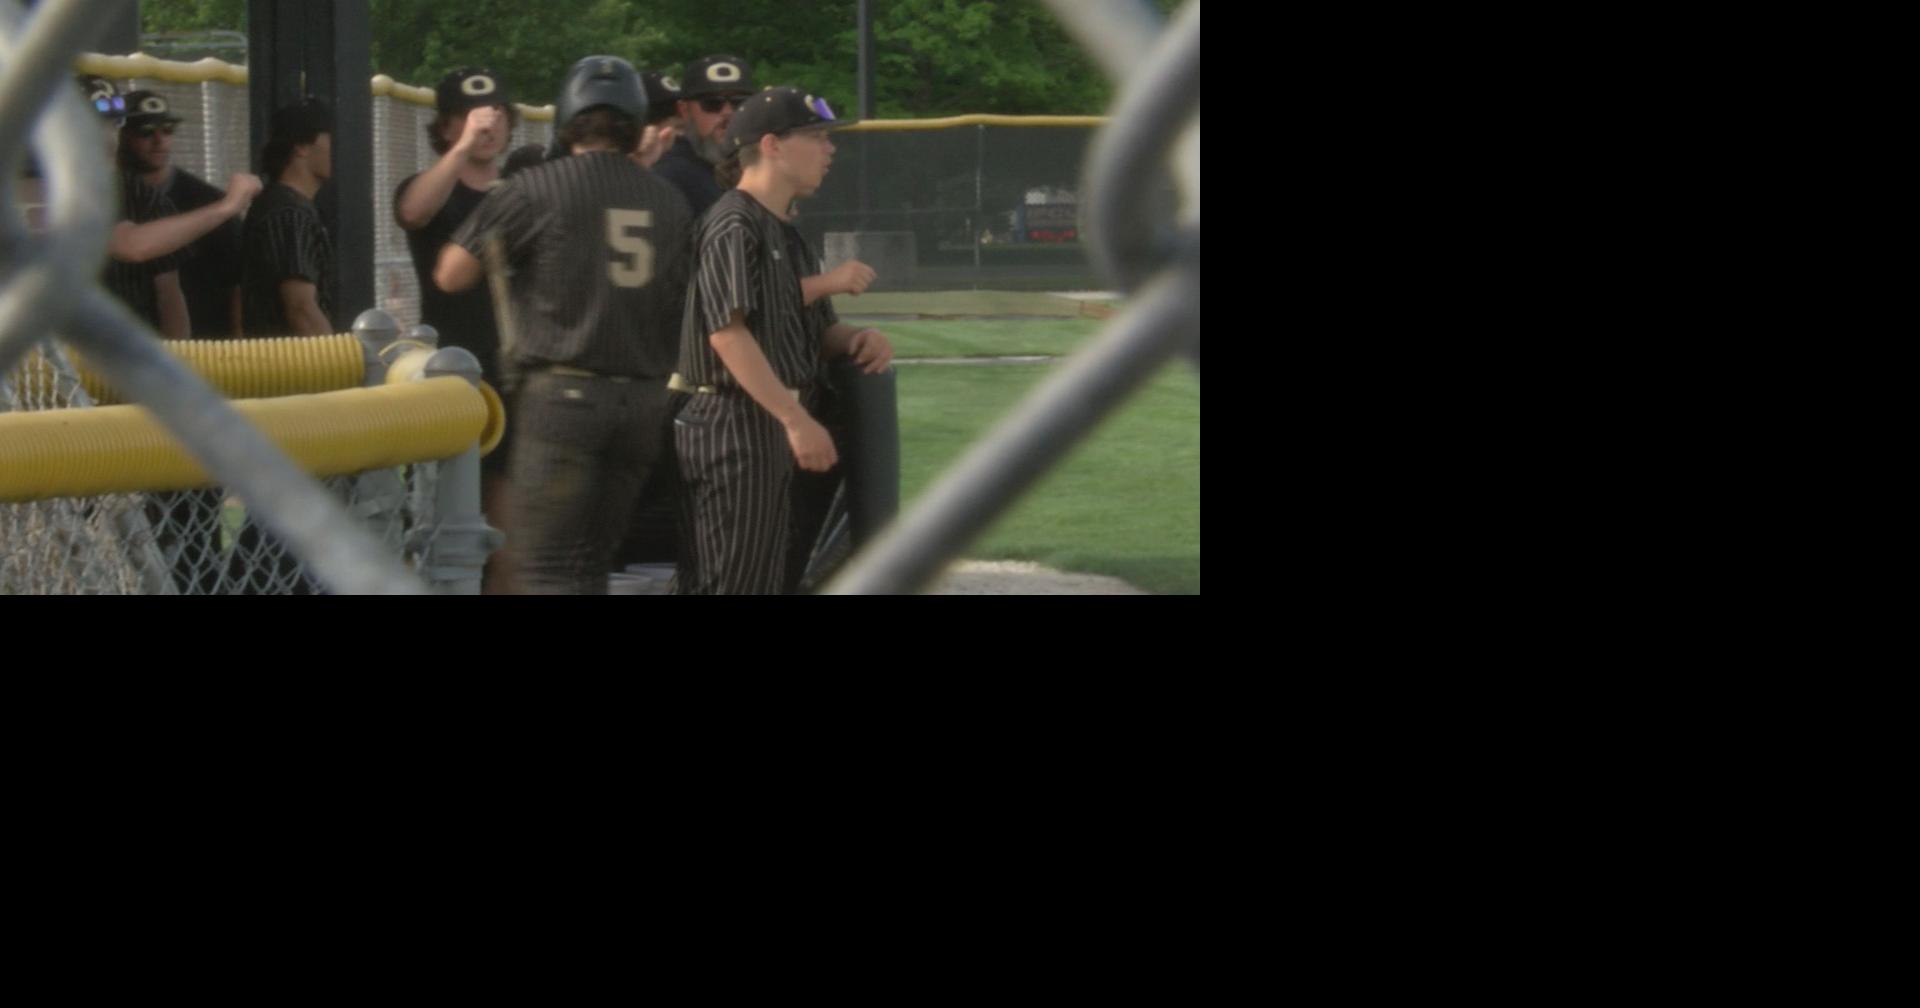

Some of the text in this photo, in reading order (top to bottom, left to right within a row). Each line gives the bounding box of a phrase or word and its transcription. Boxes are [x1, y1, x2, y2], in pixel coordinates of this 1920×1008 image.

[706, 62, 741, 83] O
[462, 75, 495, 96] O
[606, 208, 655, 288] 5
